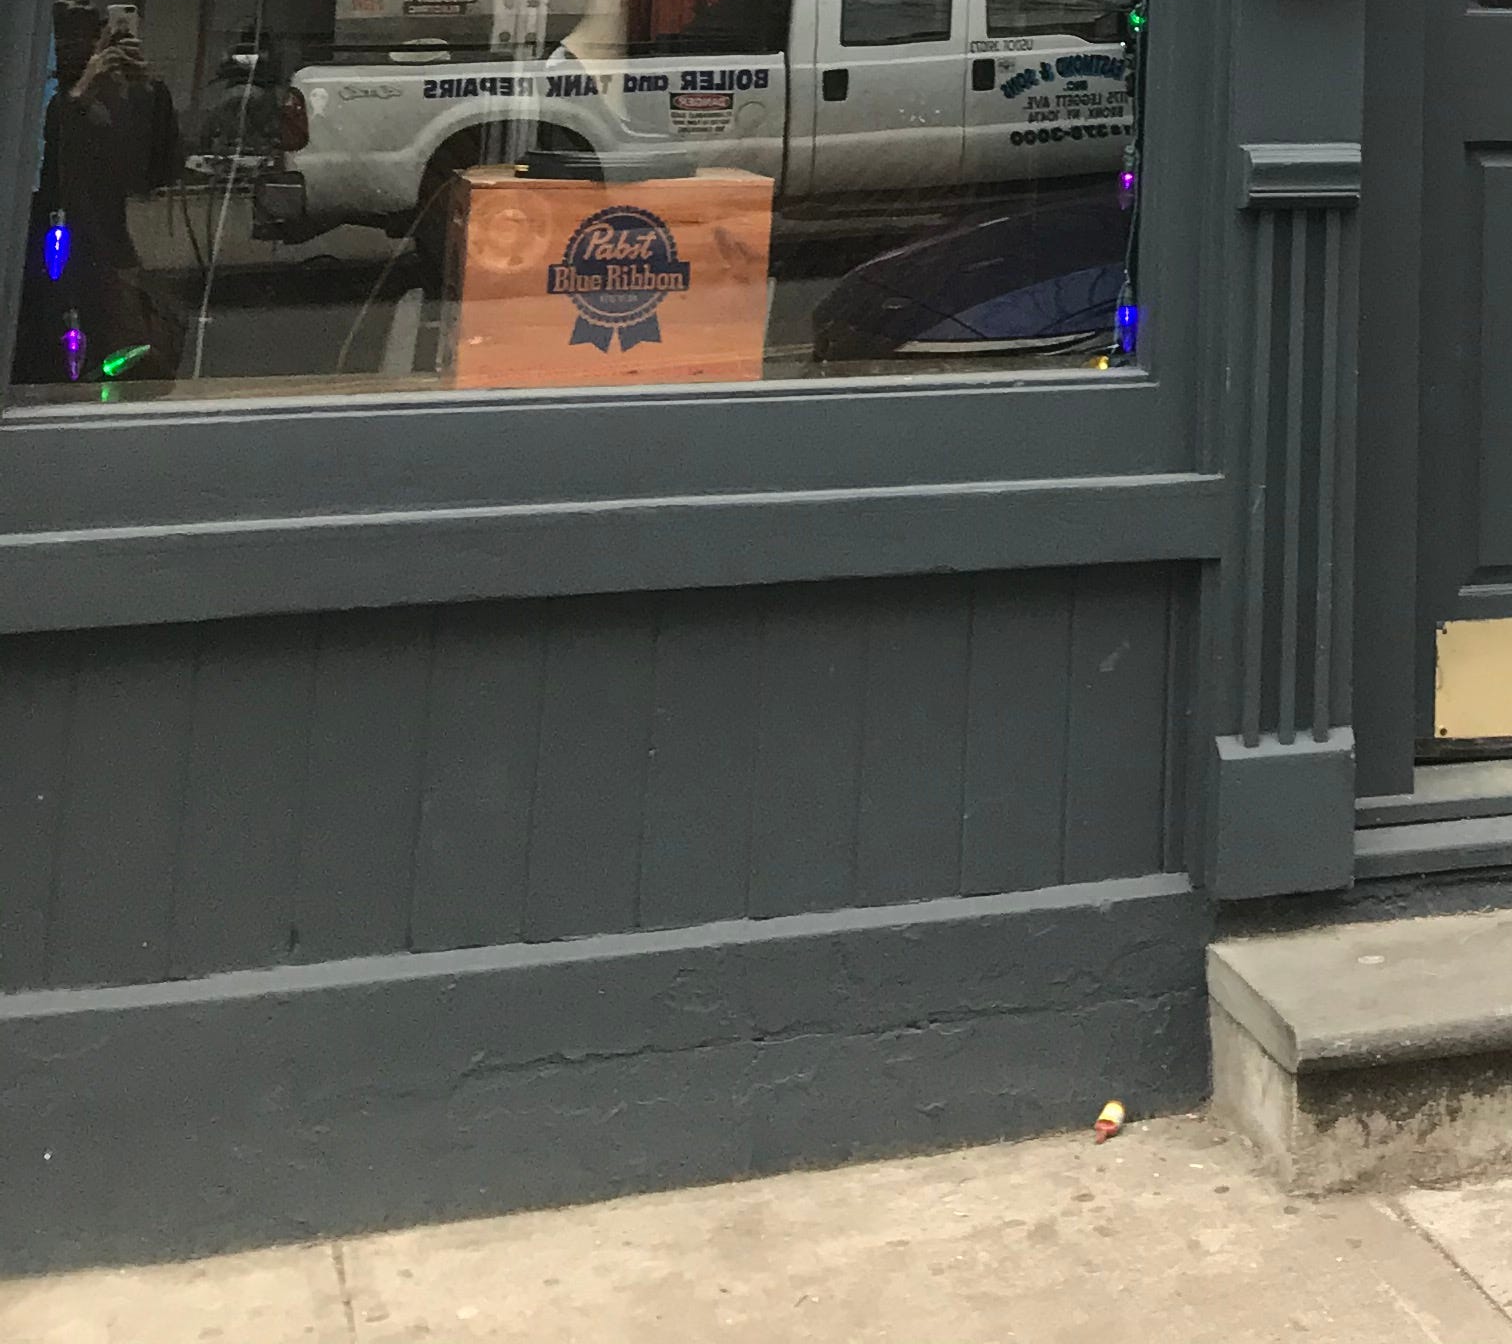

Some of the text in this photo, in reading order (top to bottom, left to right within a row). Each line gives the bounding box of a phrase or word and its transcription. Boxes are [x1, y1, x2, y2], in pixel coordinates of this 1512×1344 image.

[582, 220, 657, 261] Pabst
[552, 263, 684, 293] Blue Ribbon
